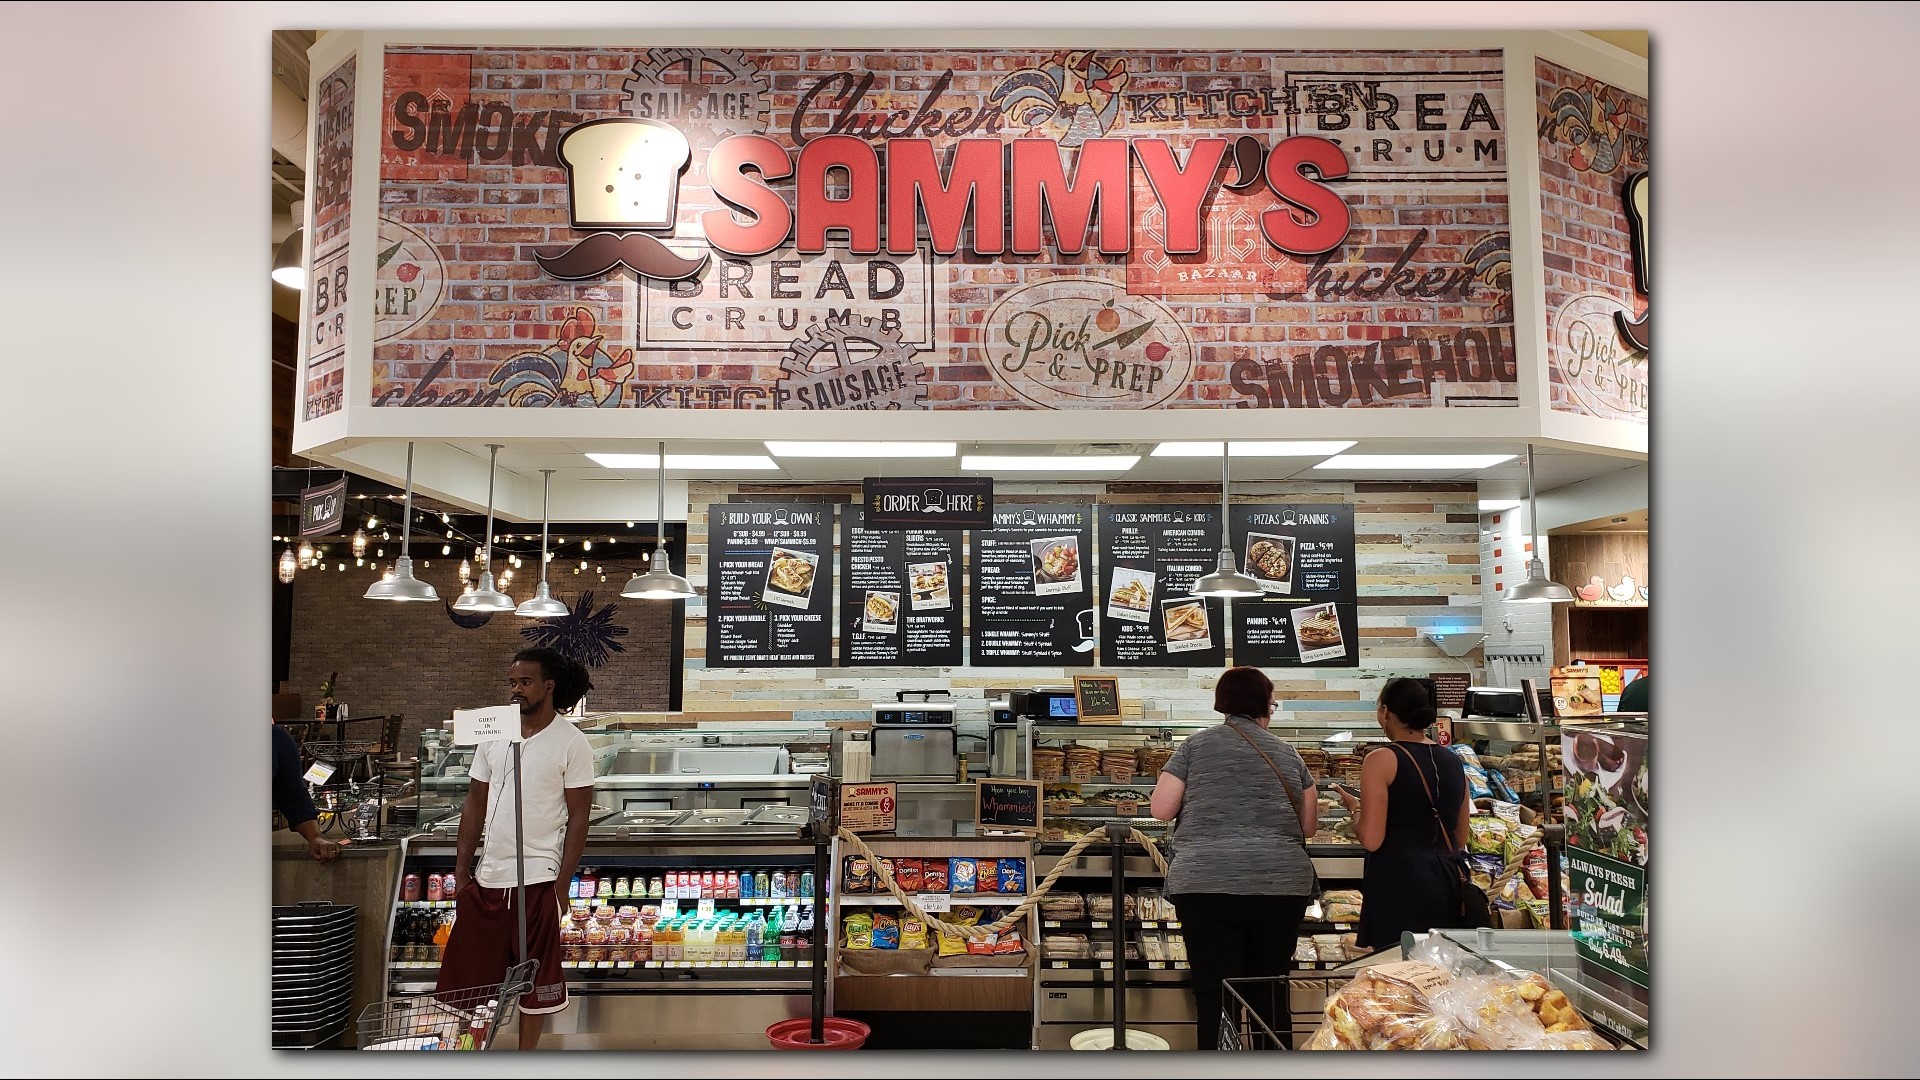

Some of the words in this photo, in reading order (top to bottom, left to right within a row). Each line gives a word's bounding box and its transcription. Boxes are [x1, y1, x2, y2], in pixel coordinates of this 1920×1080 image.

[640, 93, 750, 119] SAUSAGE
[790, 68, 1003, 147] Chicken
[1128, 80, 1380, 123] KITCHEN
[702, 133, 1351, 257] SAMMY'S
[669, 259, 905, 300] BREAD
[1177, 268, 1258, 282] BAZAAR
[1002, 310, 1093, 373] Pick
[1567, 320, 1617, 378] Pick
[796, 361, 909, 410] SAUSAGE
[1093, 357, 1164, 394] PREP
[728, 512, 750, 525] BUILD
[751, 512, 772, 525] YOUR
[790, 512, 813, 525] OWN
[883, 494, 920, 513] ORDER
[946, 494, 974, 513] HERE
[992, 511, 1021, 525] AMMY'S
[1036, 513, 1076, 525] WHAMMY
[1115, 513, 1138, 522] CLASSIC
[1193, 513, 1206, 522] KIDS
[1253, 513, 1280, 525] PIZZAS
[1298, 513, 1329, 525] PANINIS
[856, 787, 889, 796] SAMMY'S
[1571, 857, 1604, 879] ALWAYS
[1605, 867, 1636, 890] FRESH
[1585, 878, 1624, 916] Salad
[1576, 908, 1595, 922] BUILD
[1595, 916, 1604, 925] IT
[1604, 921, 1620, 932] JUST
[1621, 927, 1636, 939] THE
[1588, 937, 1604, 959] Only
[1607, 931, 1624, 944] LIKE
[1625, 938, 1632, 948] IT
